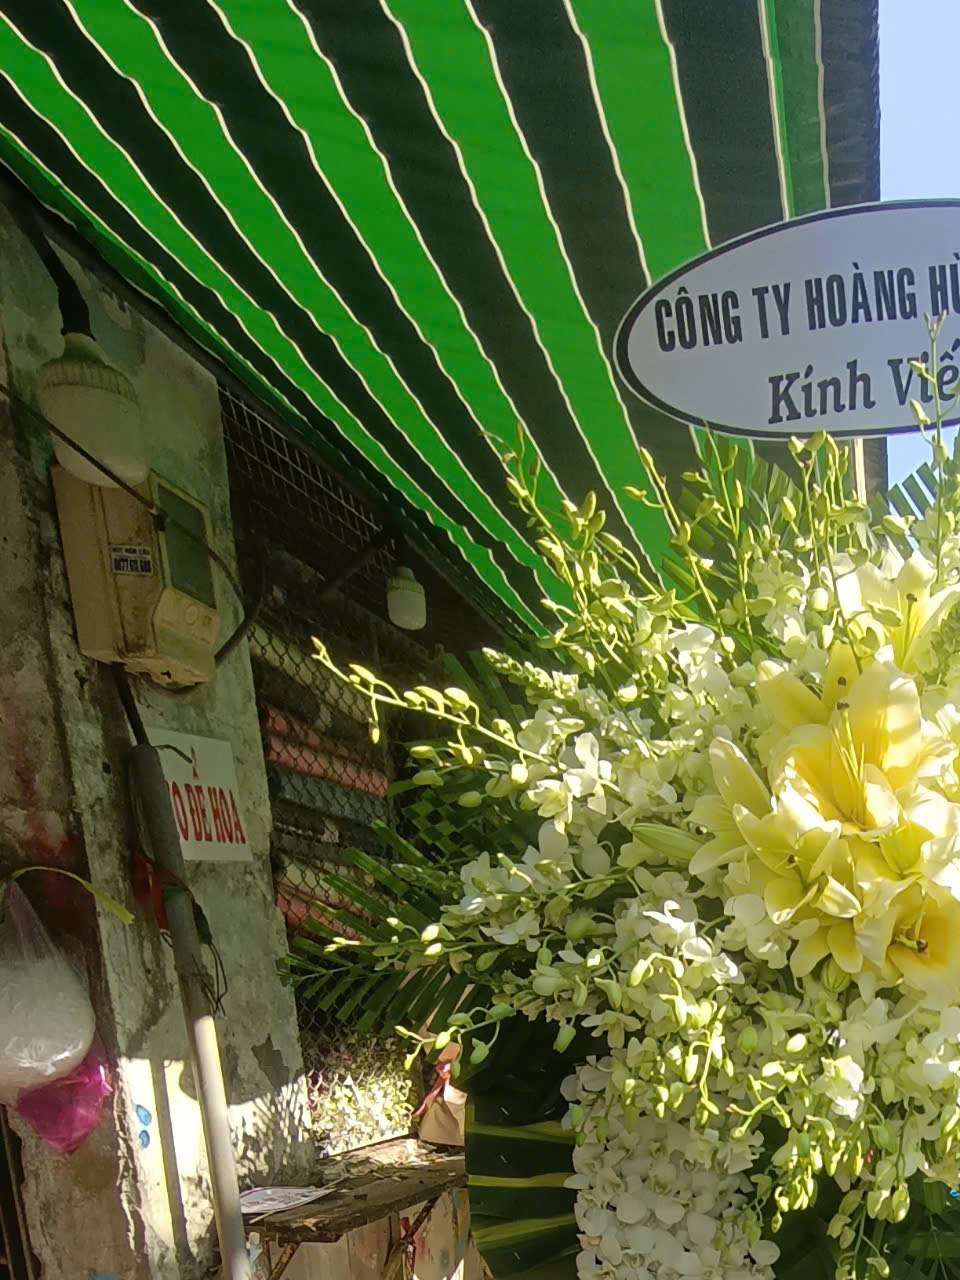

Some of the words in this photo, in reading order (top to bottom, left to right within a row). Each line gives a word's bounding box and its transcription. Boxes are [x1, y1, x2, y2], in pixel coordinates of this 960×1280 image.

[654, 286, 743, 352] CÔNG
[751, 282, 791, 339] TY
[804, 261, 918, 331] HOÀNG
[768, 358, 876, 425] Kính
[207, 786, 247, 844] HOA
